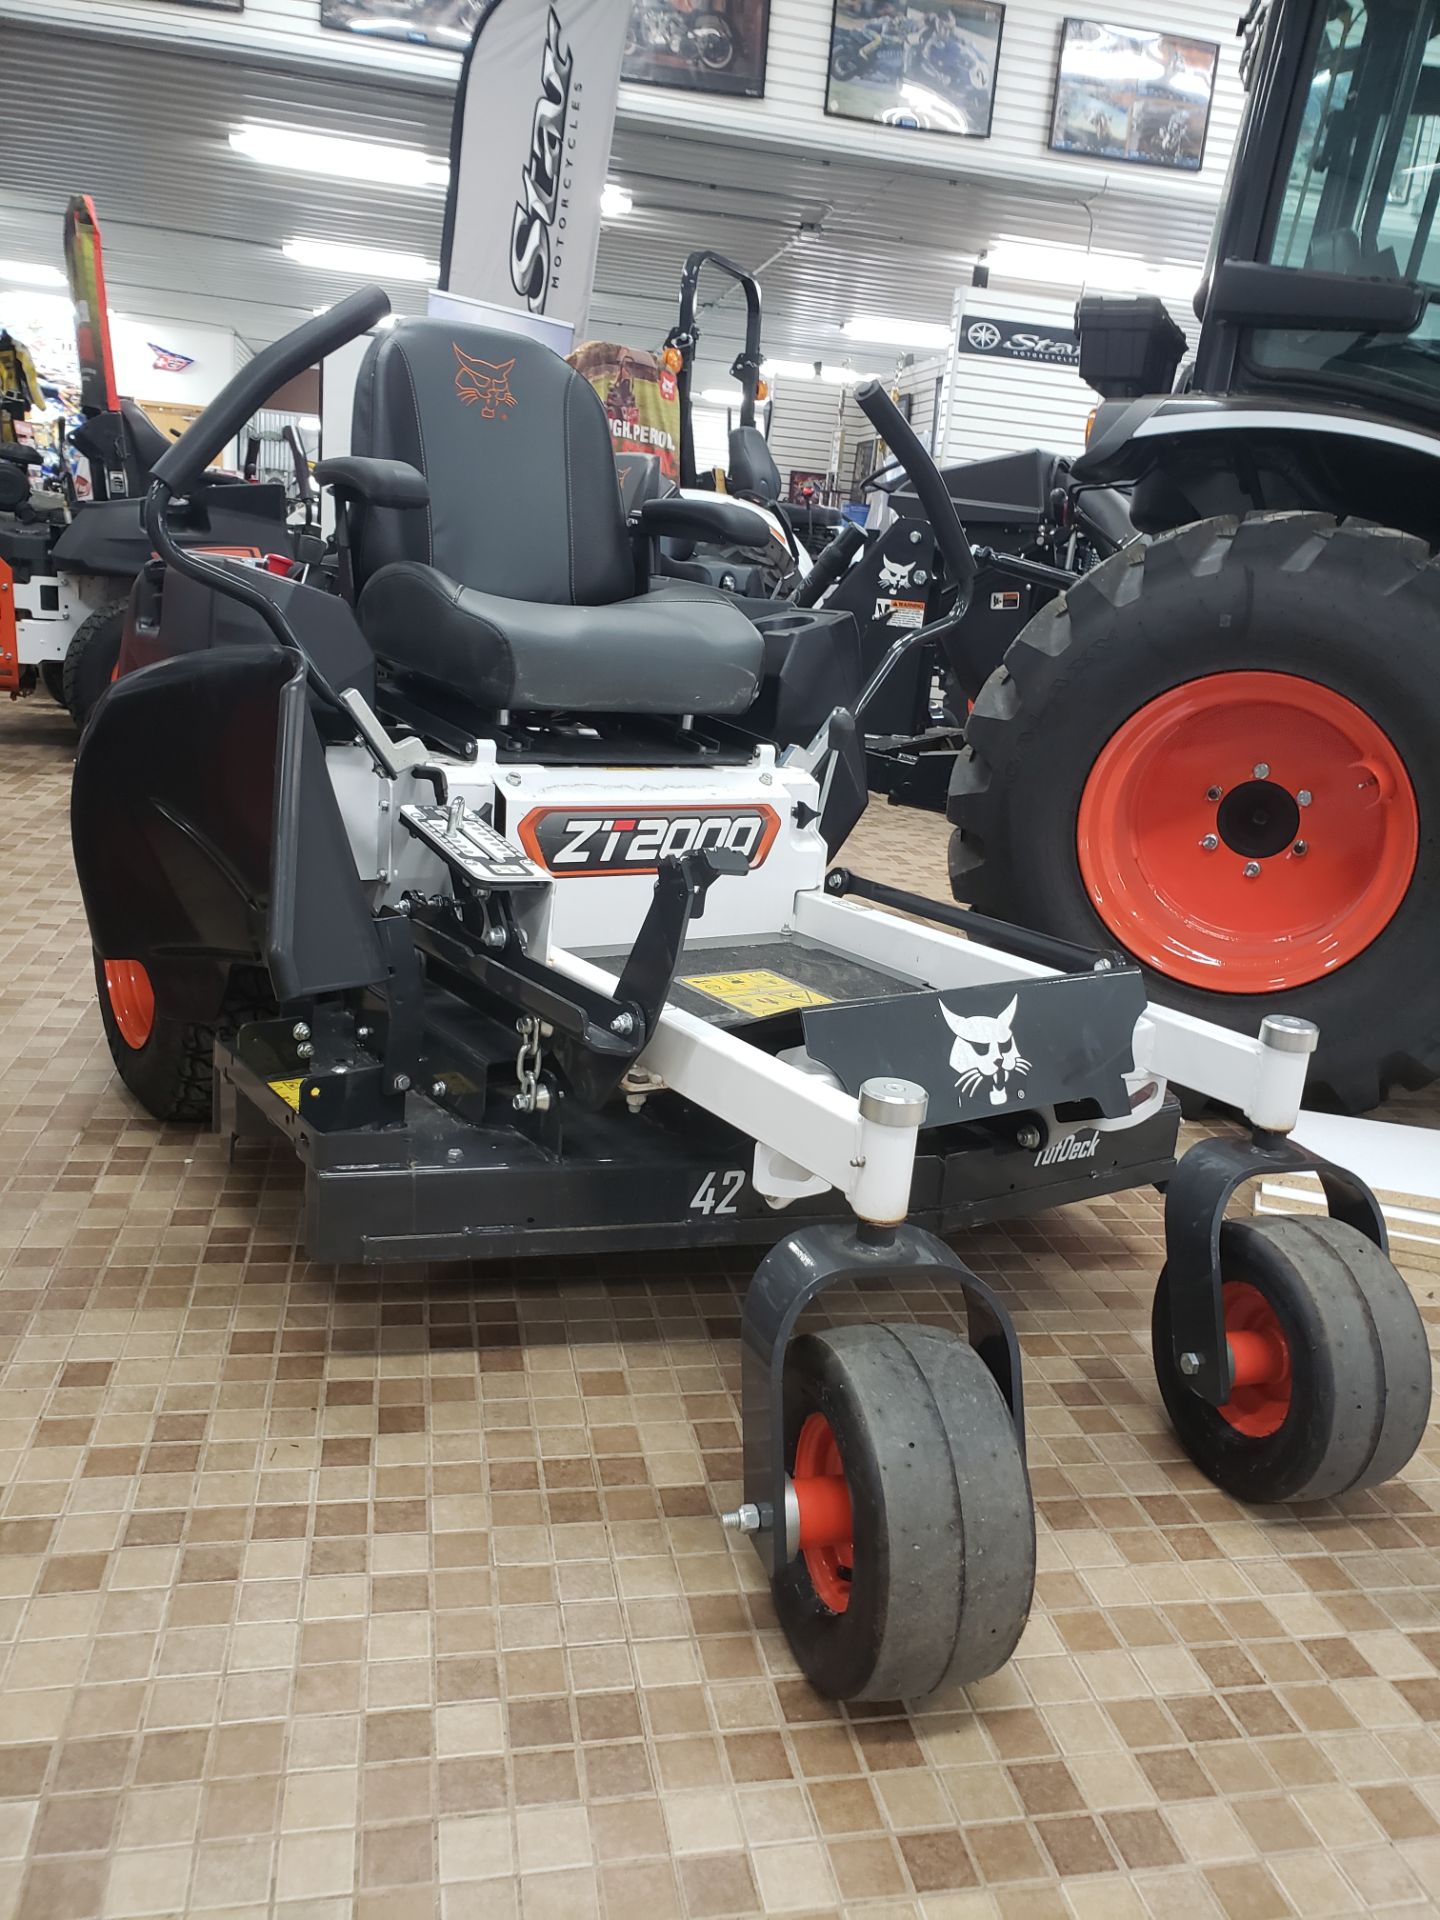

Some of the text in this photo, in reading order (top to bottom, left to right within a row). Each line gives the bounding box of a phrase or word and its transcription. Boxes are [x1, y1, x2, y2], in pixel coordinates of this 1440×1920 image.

[510, 4, 573, 315] Star
[551, 82, 583, 289] MOTORCYCLES
[552, 817, 762, 863] ZT2000
[690, 1170, 746, 1215] 42
